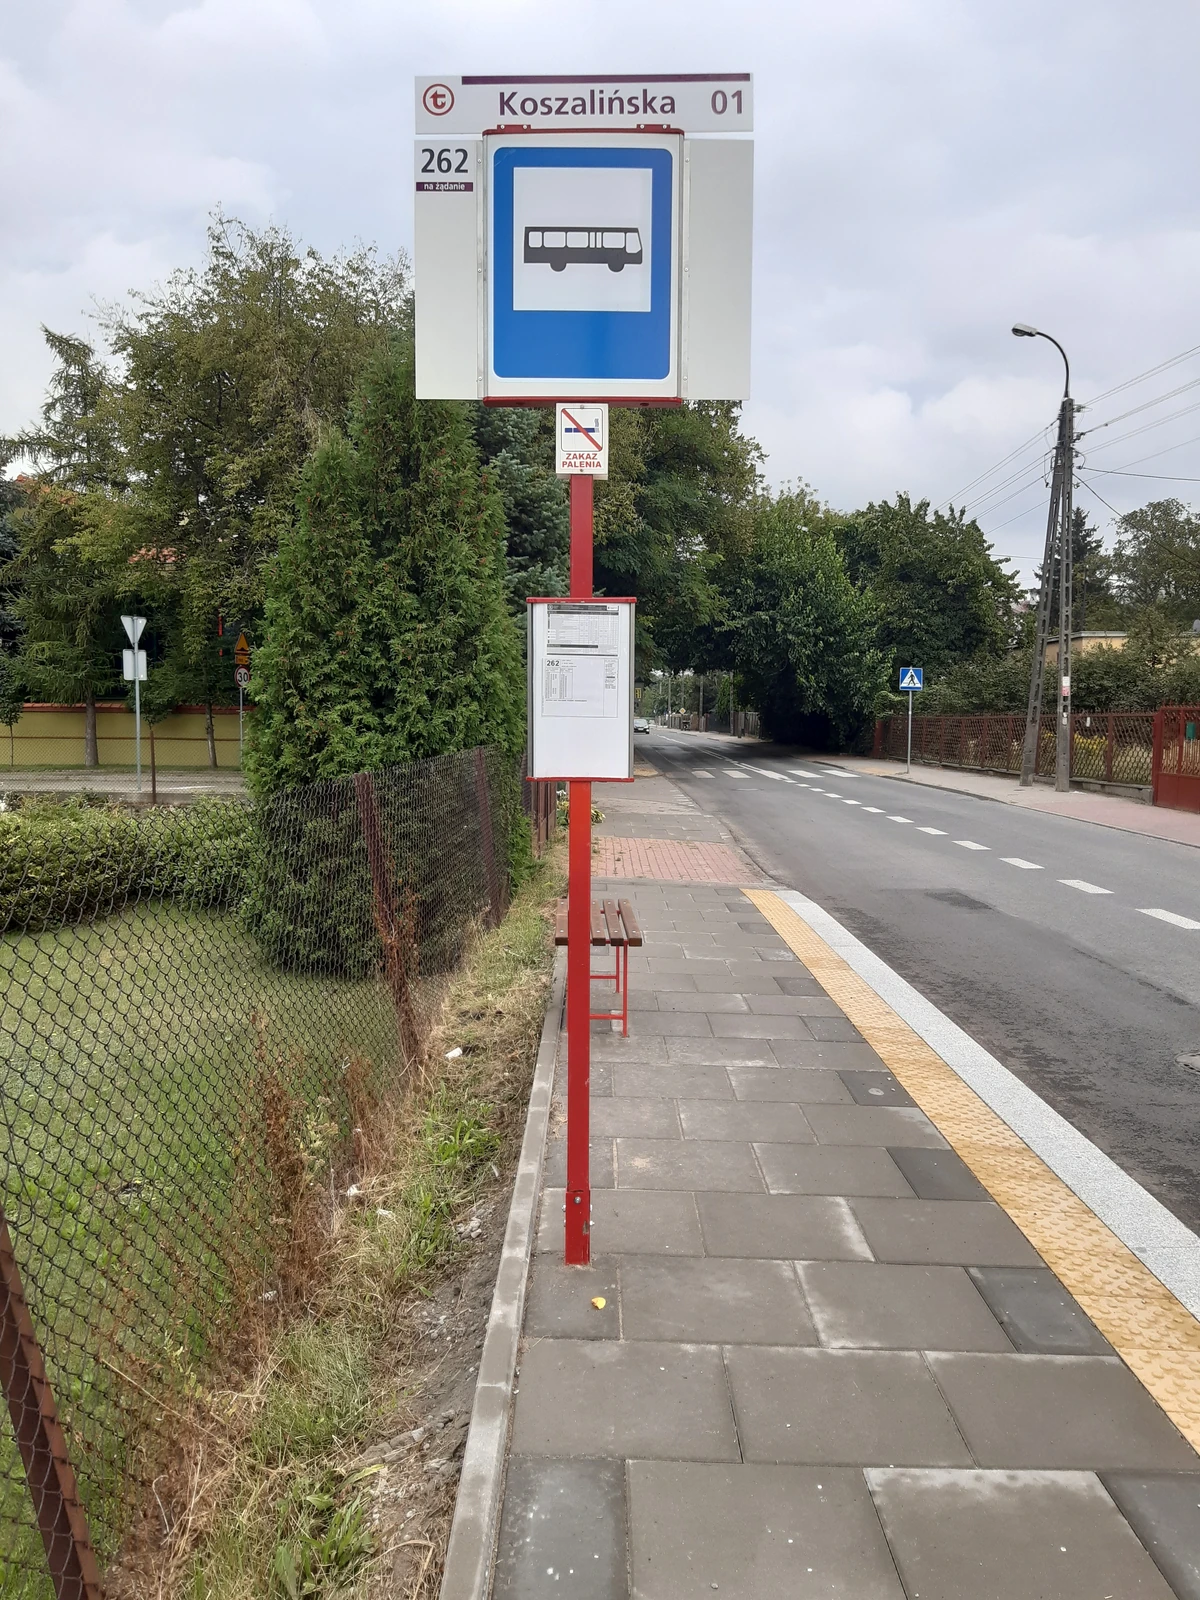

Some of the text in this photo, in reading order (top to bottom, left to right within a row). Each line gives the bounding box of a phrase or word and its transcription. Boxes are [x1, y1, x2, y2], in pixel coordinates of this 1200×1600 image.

[499, 88, 743, 116] Koszalińska 01
[421, 148, 469, 173] 262
[435, 182, 466, 192] żądanie
[546, 659, 560, 667] 262
[237, 672, 249, 682] 30
